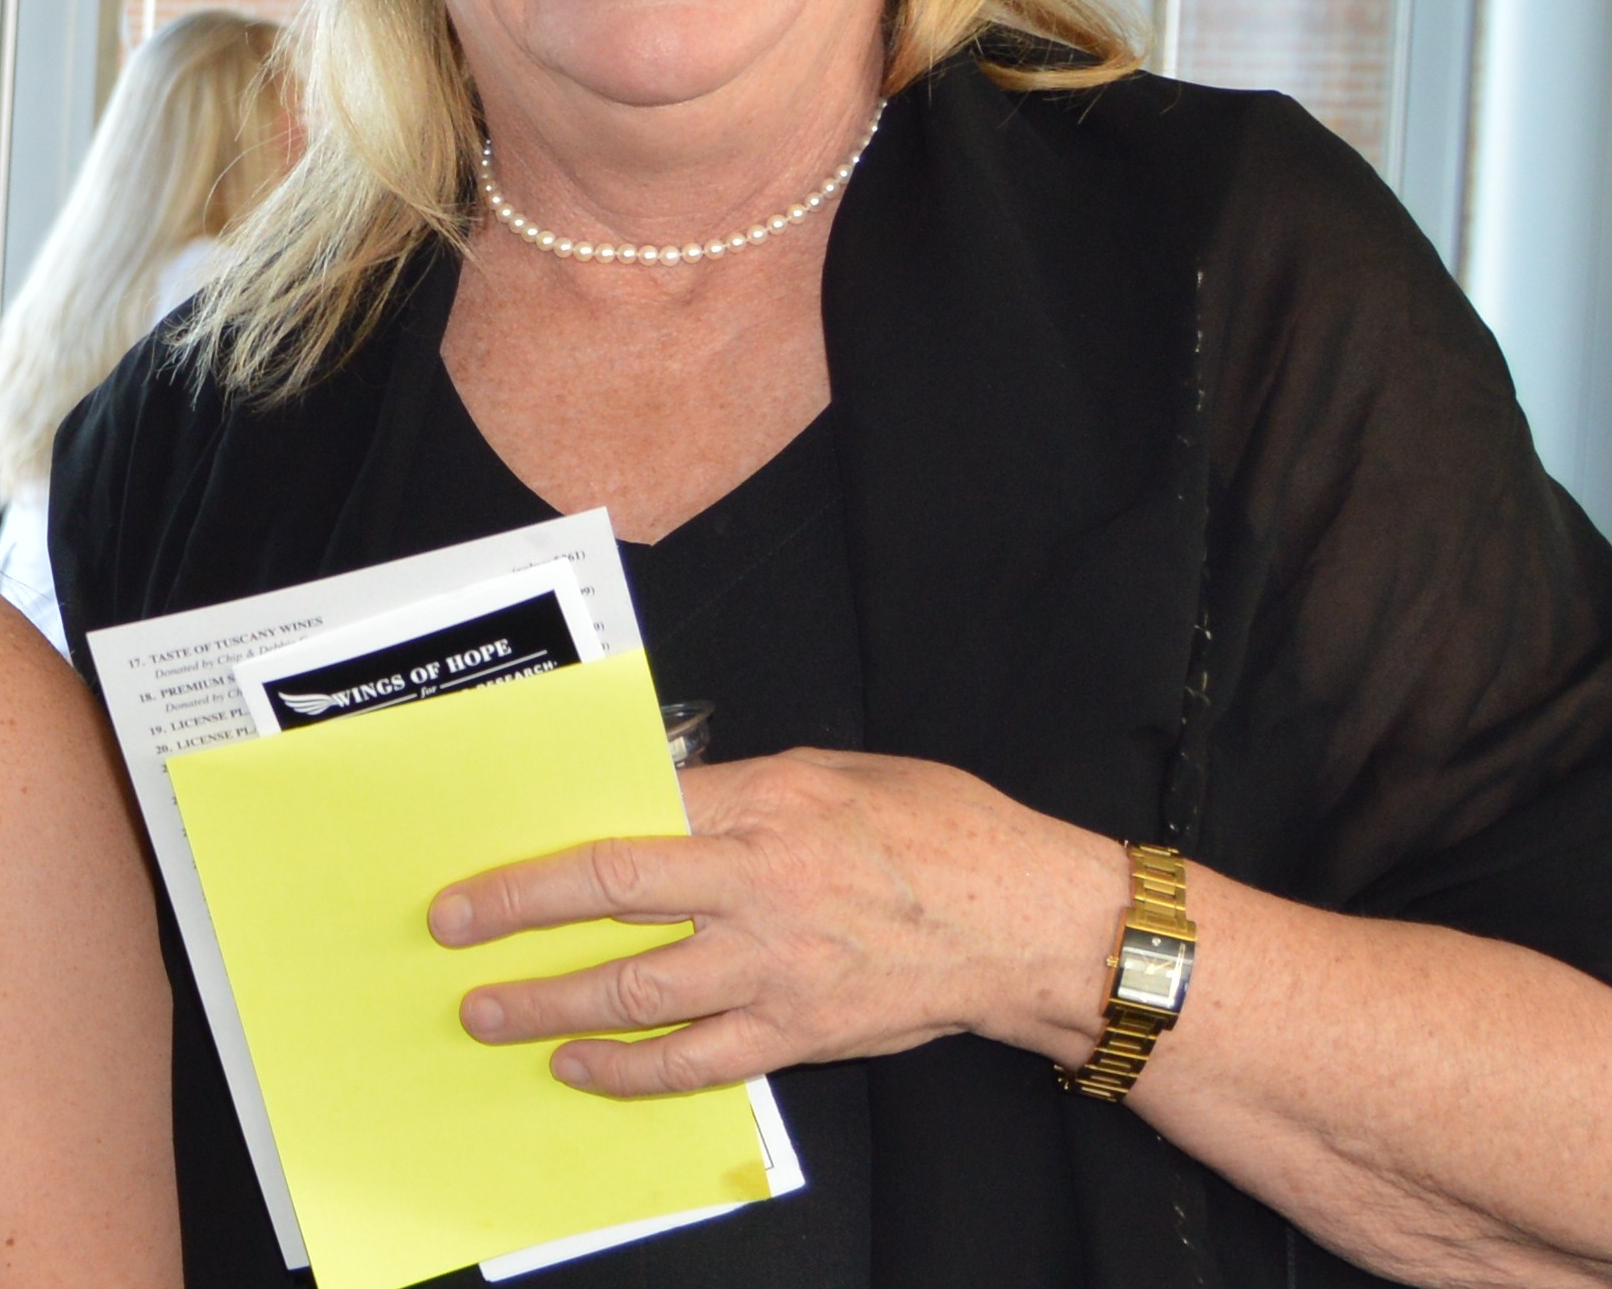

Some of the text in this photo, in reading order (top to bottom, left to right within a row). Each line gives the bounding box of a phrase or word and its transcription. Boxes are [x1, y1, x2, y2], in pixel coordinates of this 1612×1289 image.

[149, 648, 192, 665] TASTE
[193, 642, 212, 655] OF
[213, 627, 277, 651] TUSCANY
[279, 616, 324, 635] WINES
[155, 659, 199, 679] Donated
[202, 657, 215, 669] by
[217, 650, 243, 664] Chip
[245, 649, 255, 658] &
[330, 638, 512, 708] WINGS OF HOPE
[139, 692, 156, 704] 18.
[159, 675, 225, 699] PREMIUM
[165, 694, 210, 713] Donated
[212, 692, 225, 703] by
[420, 684, 439, 699] for
[148, 726, 167, 737] 19.
[170, 710, 229, 732] LICENSE
[155, 744, 173, 755] 20.
[176, 728, 234, 751] LICENSE
